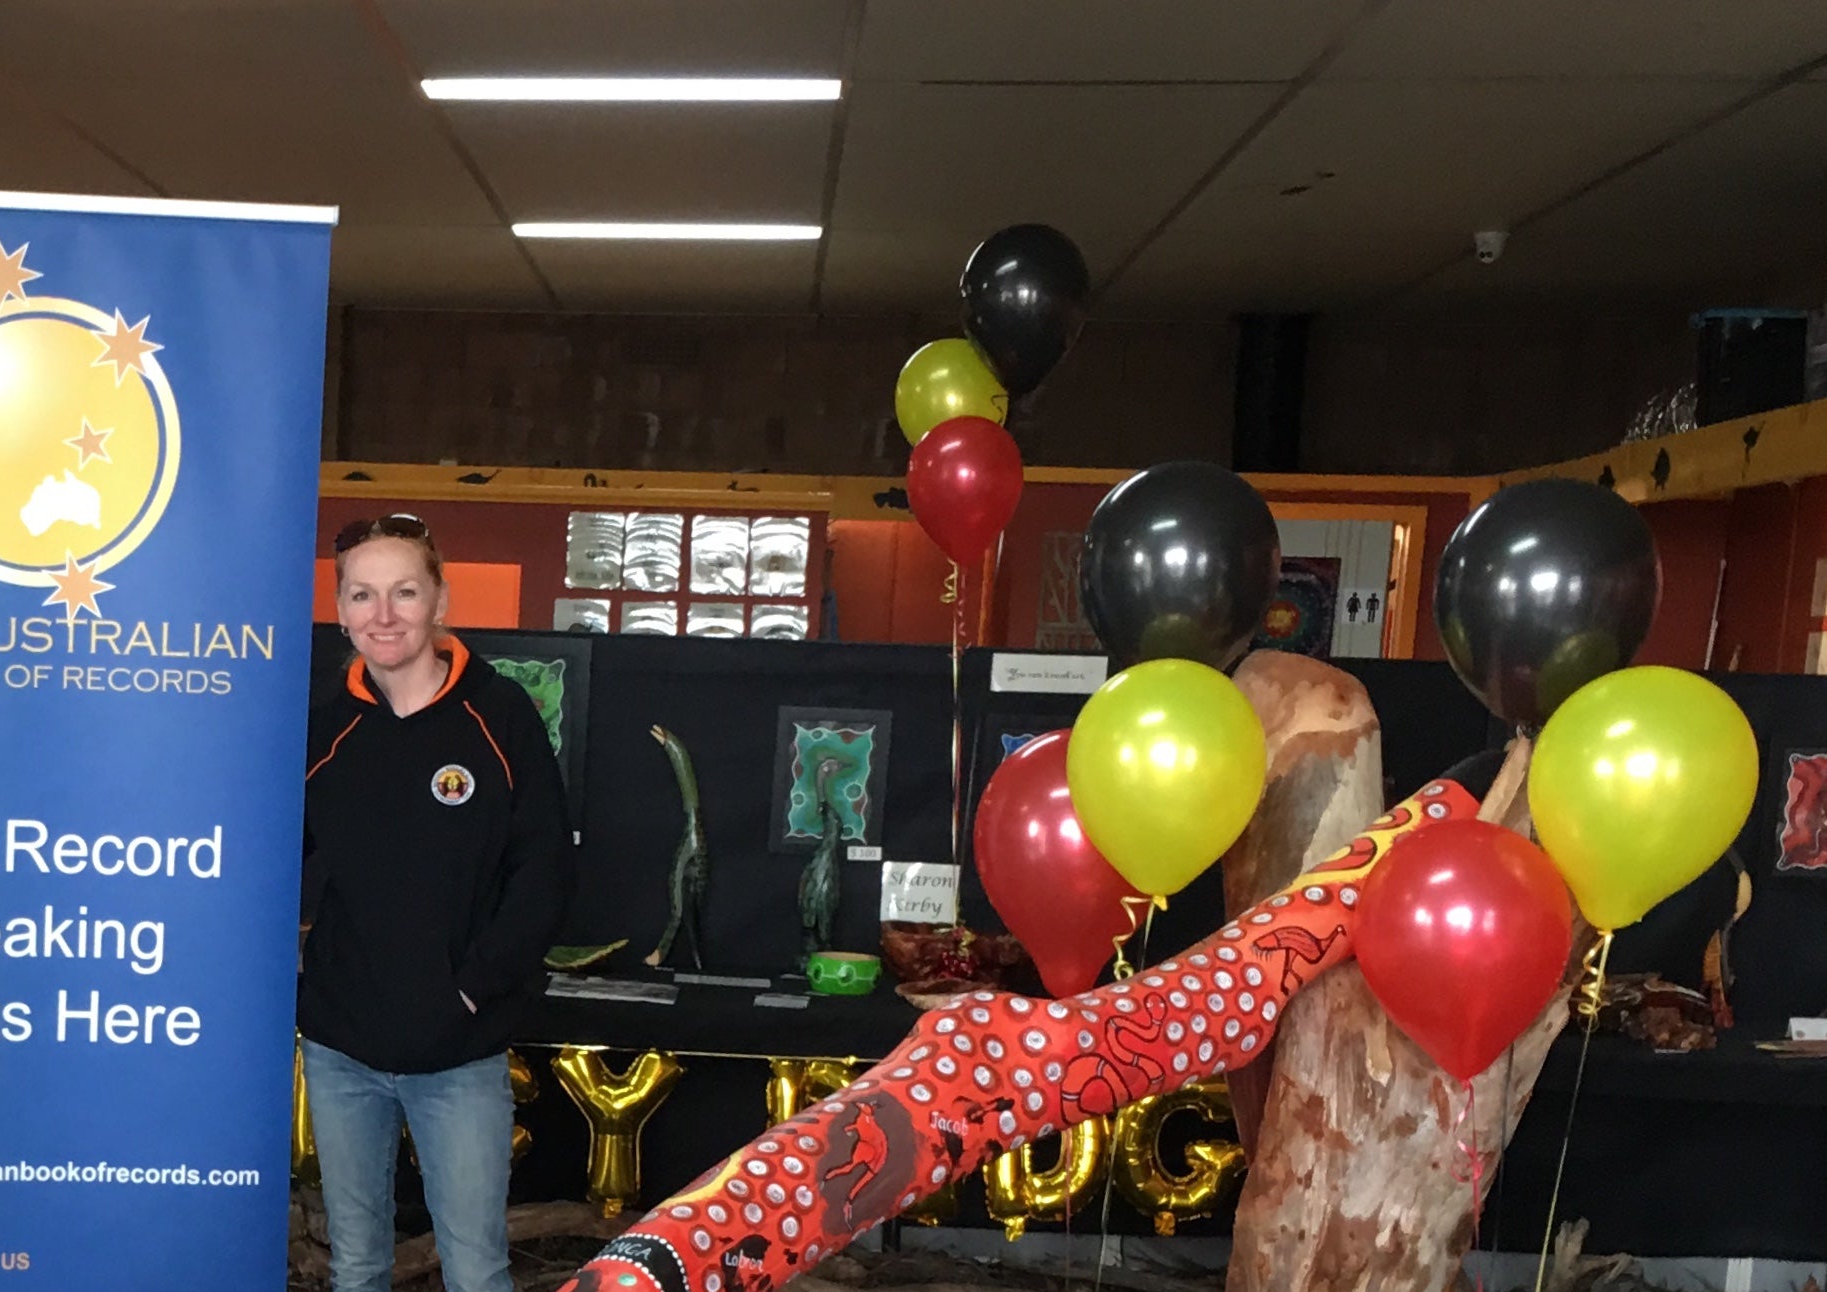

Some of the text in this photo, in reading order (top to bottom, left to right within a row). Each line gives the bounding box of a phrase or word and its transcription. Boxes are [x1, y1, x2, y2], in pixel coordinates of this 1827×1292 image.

[4, 664, 53, 690] OF
[62, 665, 233, 695] RECORDS
[4, 819, 224, 879] Record
[56, 989, 202, 1046] Here
[929, 1110, 970, 1138] Jacob
[0, 1251, 31, 1272] US
